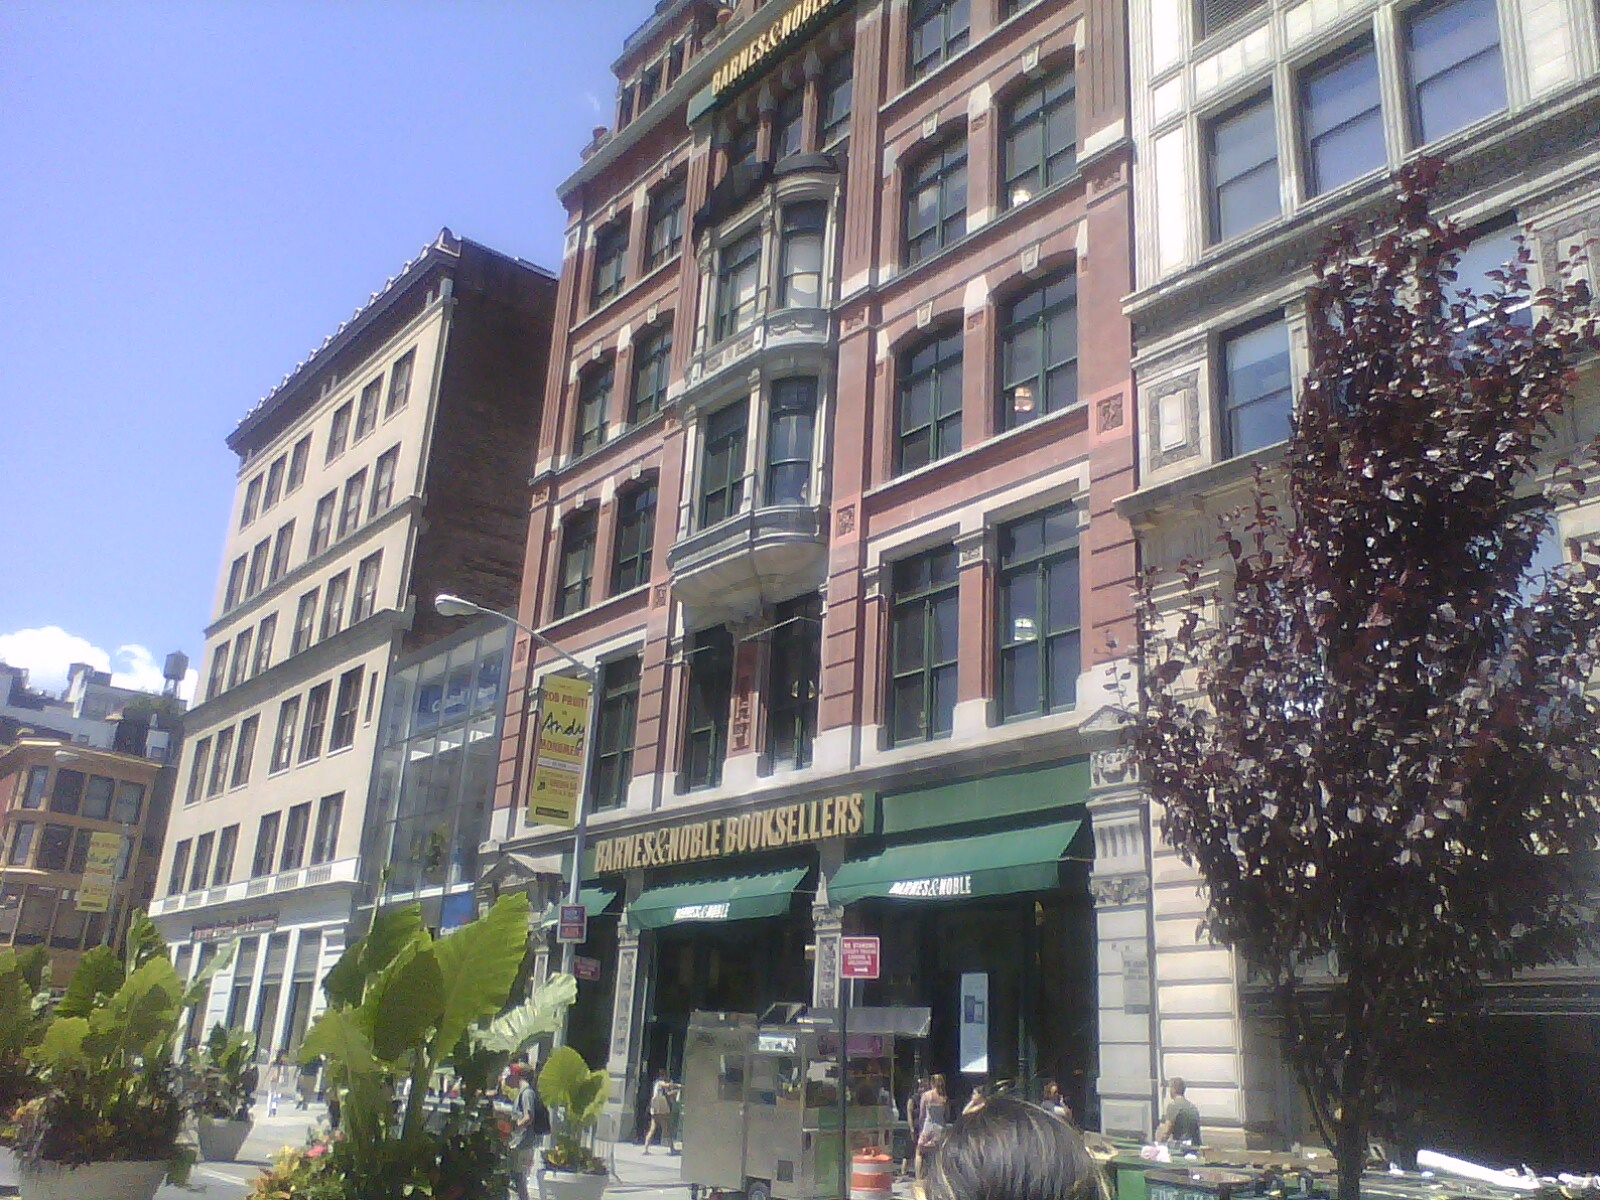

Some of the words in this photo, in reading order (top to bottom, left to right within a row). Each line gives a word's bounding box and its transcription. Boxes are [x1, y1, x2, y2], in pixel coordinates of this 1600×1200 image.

[711, 0, 829, 97] BARNES&NOBL
[541, 711, 585, 749] Andy
[723, 793, 864, 856] BOOKSELLERS
